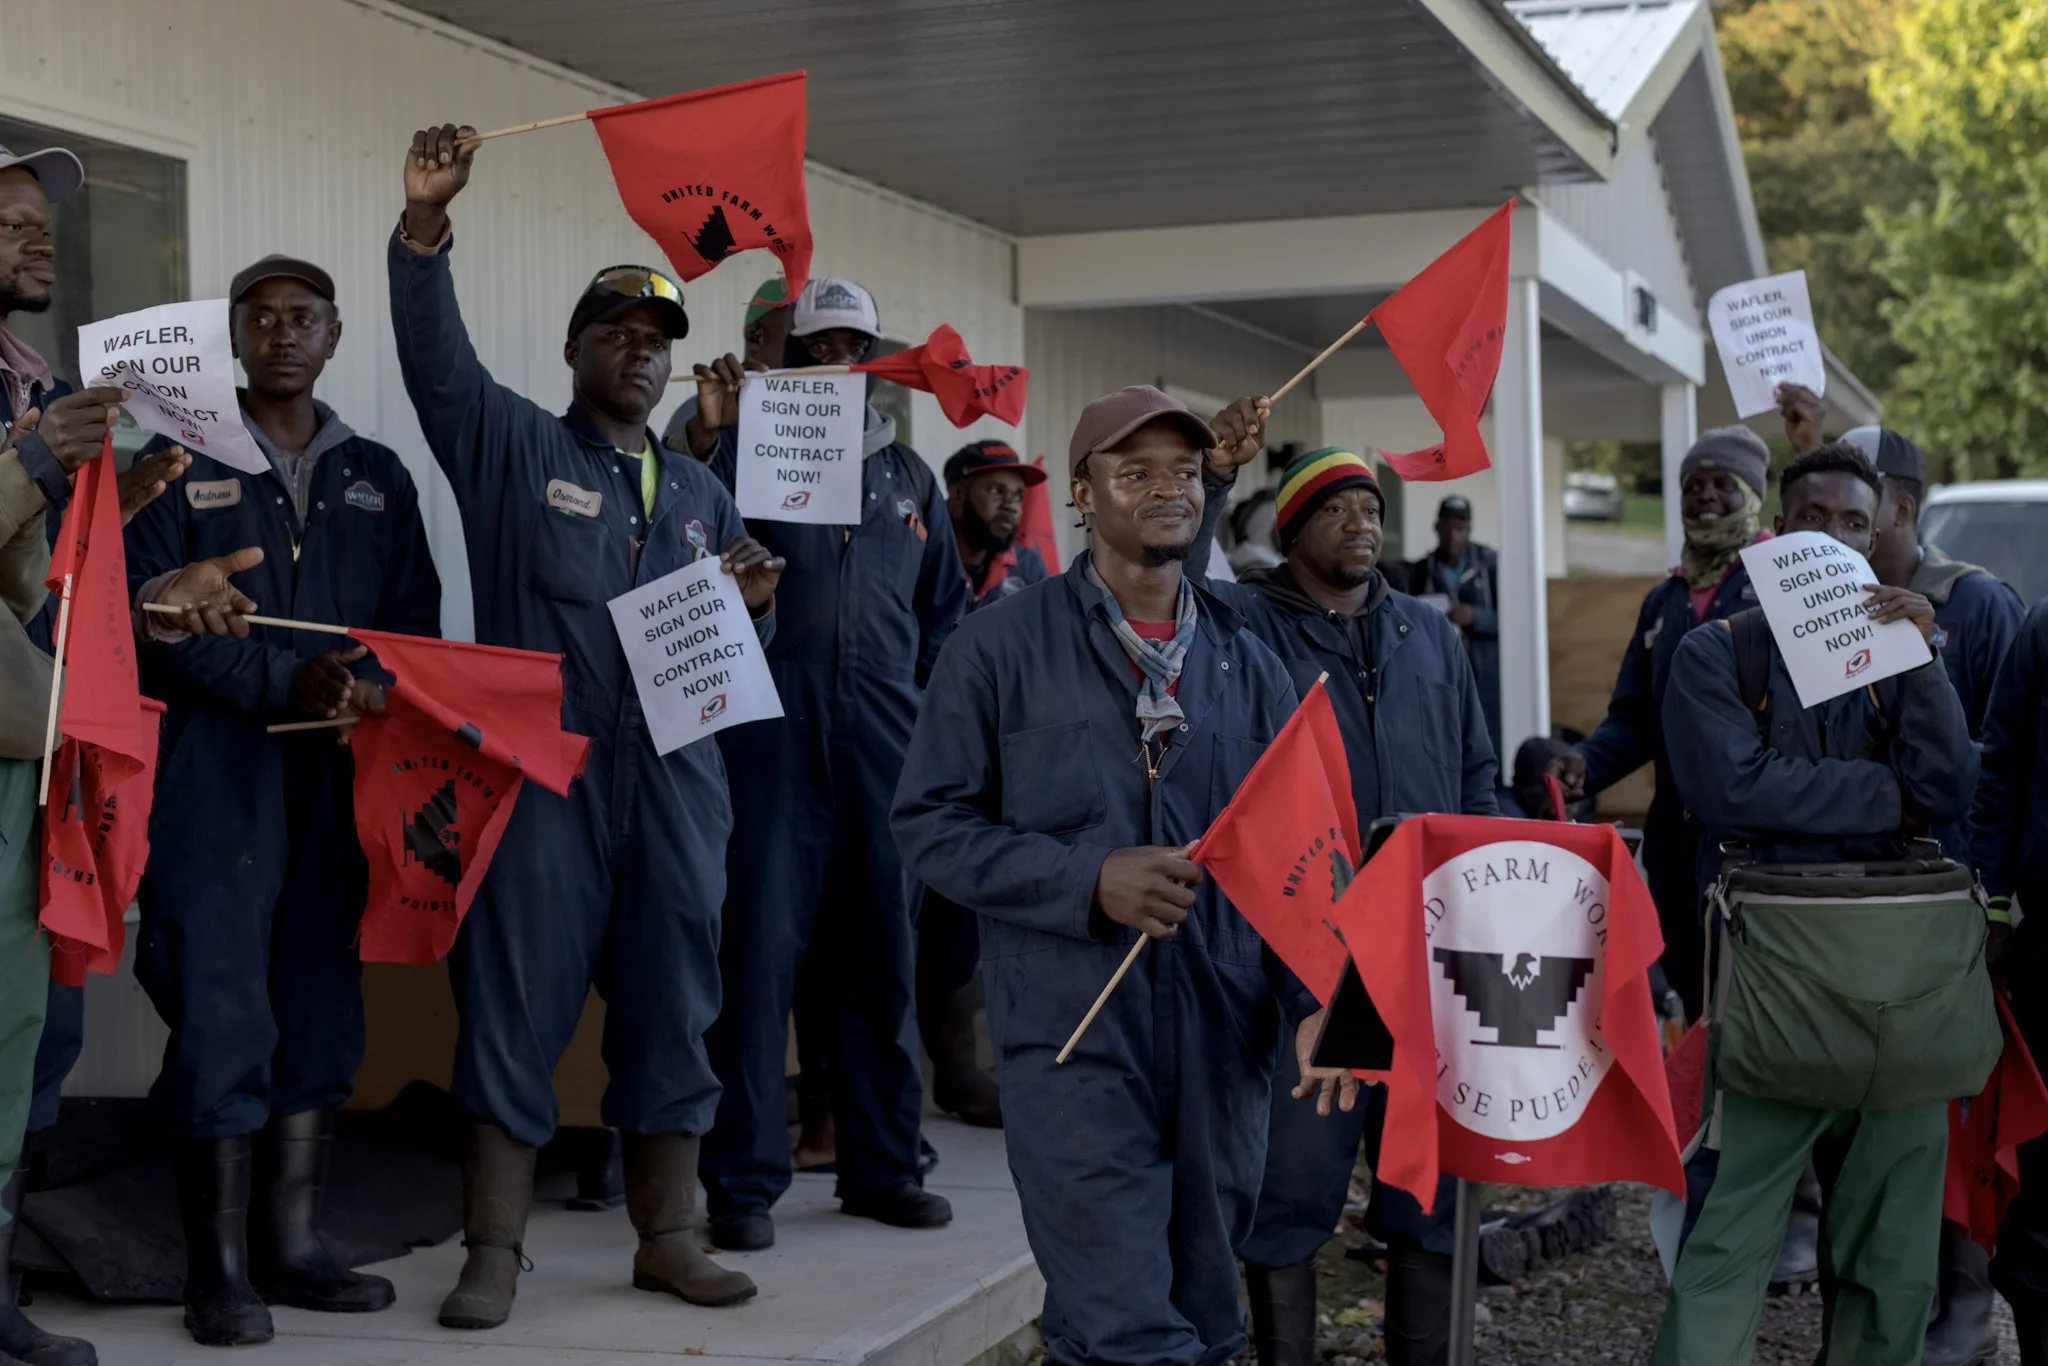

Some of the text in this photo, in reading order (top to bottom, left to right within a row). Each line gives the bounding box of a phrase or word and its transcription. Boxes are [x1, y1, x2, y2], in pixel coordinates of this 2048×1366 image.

[661, 185, 714, 204] UNITED
[722, 190, 763, 221] FARM
[1727, 290, 1788, 313] WAFLER,
[1730, 307, 1793, 332] SIGN OUR
[103, 326, 194, 353] WAFLER,
[1745, 326, 1787, 345] UNION
[152, 355, 201, 375] OUR
[1735, 340, 1805, 367] CONTRACT
[1759, 361, 1794, 379] NOW!
[765, 378, 839, 396] WAFLER,
[761, 400, 841, 417] SIGN OUR
[775, 424, 826, 439] UNION
[755, 444, 845, 462] CONTRACT
[776, 468, 821, 484] NOW!
[193, 489, 232, 501] Andrew
[552, 488, 591, 509] Osmond
[1772, 545, 1847, 570] WAFLER,
[1779, 562, 1859, 593] SIGN OUR
[639, 578, 716, 620] WAFLER,
[1803, 581, 1859, 609] UNION
[645, 598, 727, 642] SIGN OUR
[665, 624, 720, 657] UNION
[1825, 624, 1874, 652] NOW!
[653, 643, 745, 688] CONTRACT
[683, 670, 732, 699] NOW!
[392, 756, 494, 799] UNITED FARM
[1461, 857, 1551, 894] FARM
[1453, 1082, 1492, 1117] SE
